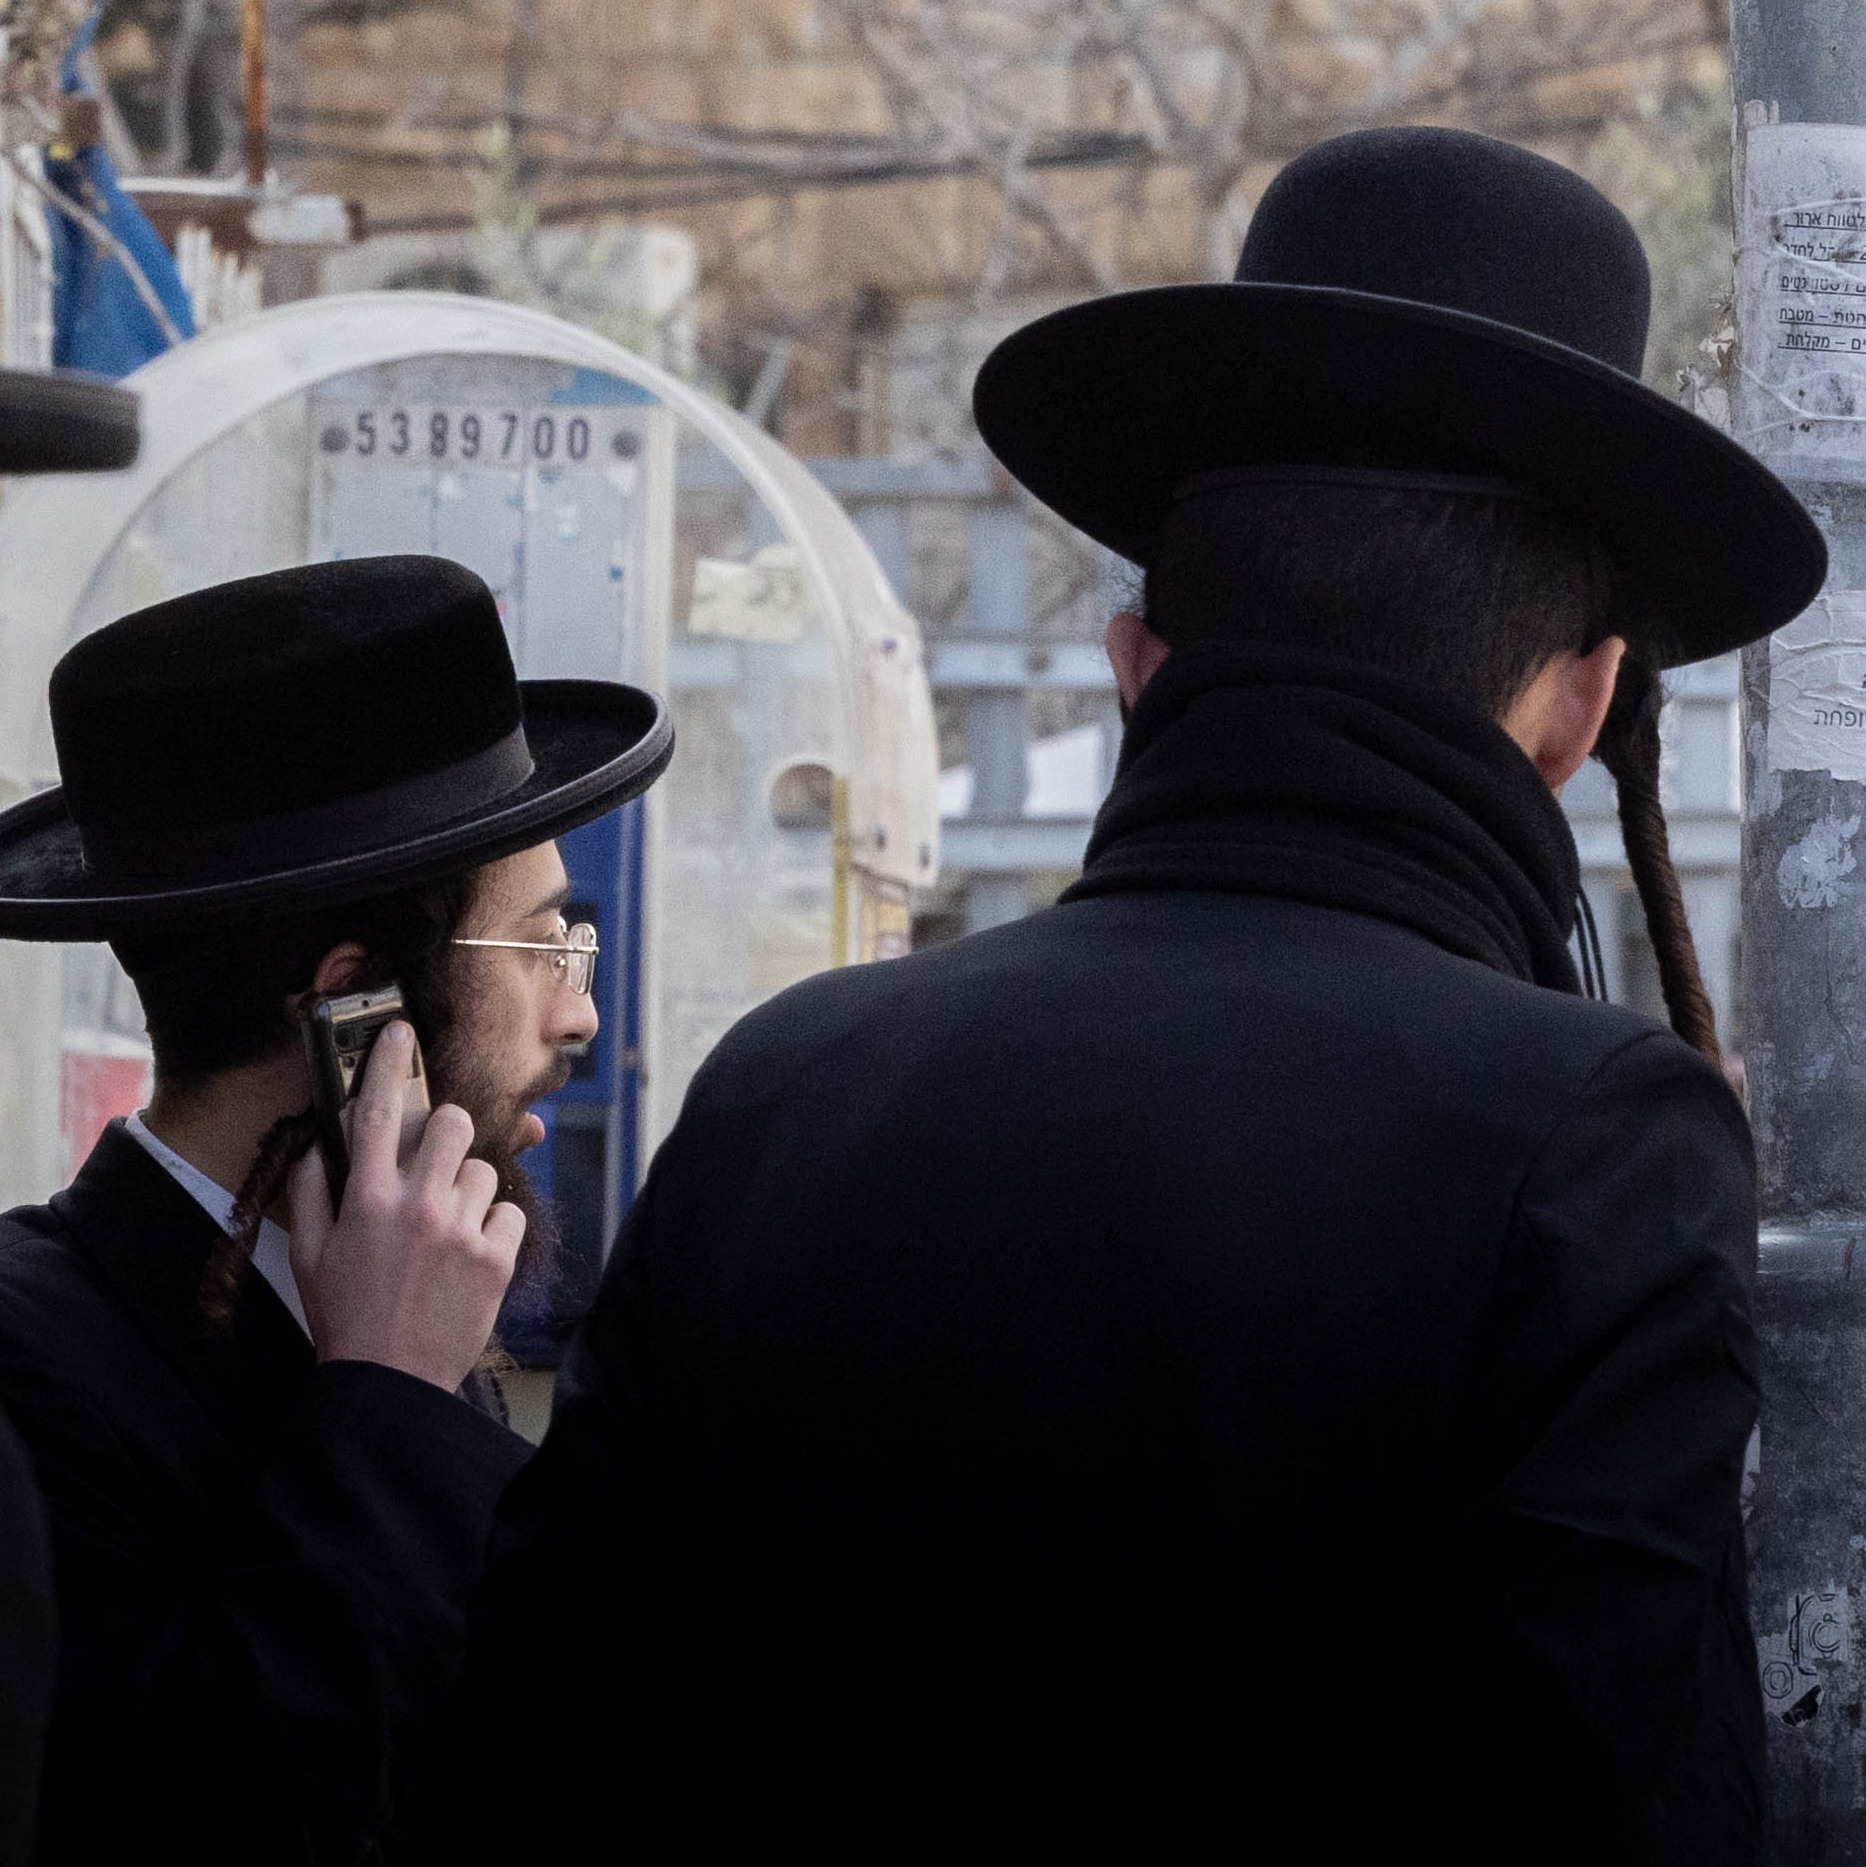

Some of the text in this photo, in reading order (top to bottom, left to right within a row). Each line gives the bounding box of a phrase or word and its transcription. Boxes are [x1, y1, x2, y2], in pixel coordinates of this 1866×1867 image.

[1794, 212, 1822, 227] ארוך
[1827, 213, 1865, 228] לטווח
[1779, 307, 1814, 322] מטבח
[1786, 331, 1830, 348] מקלחת
[355, 410, 591, 461] 5389700
